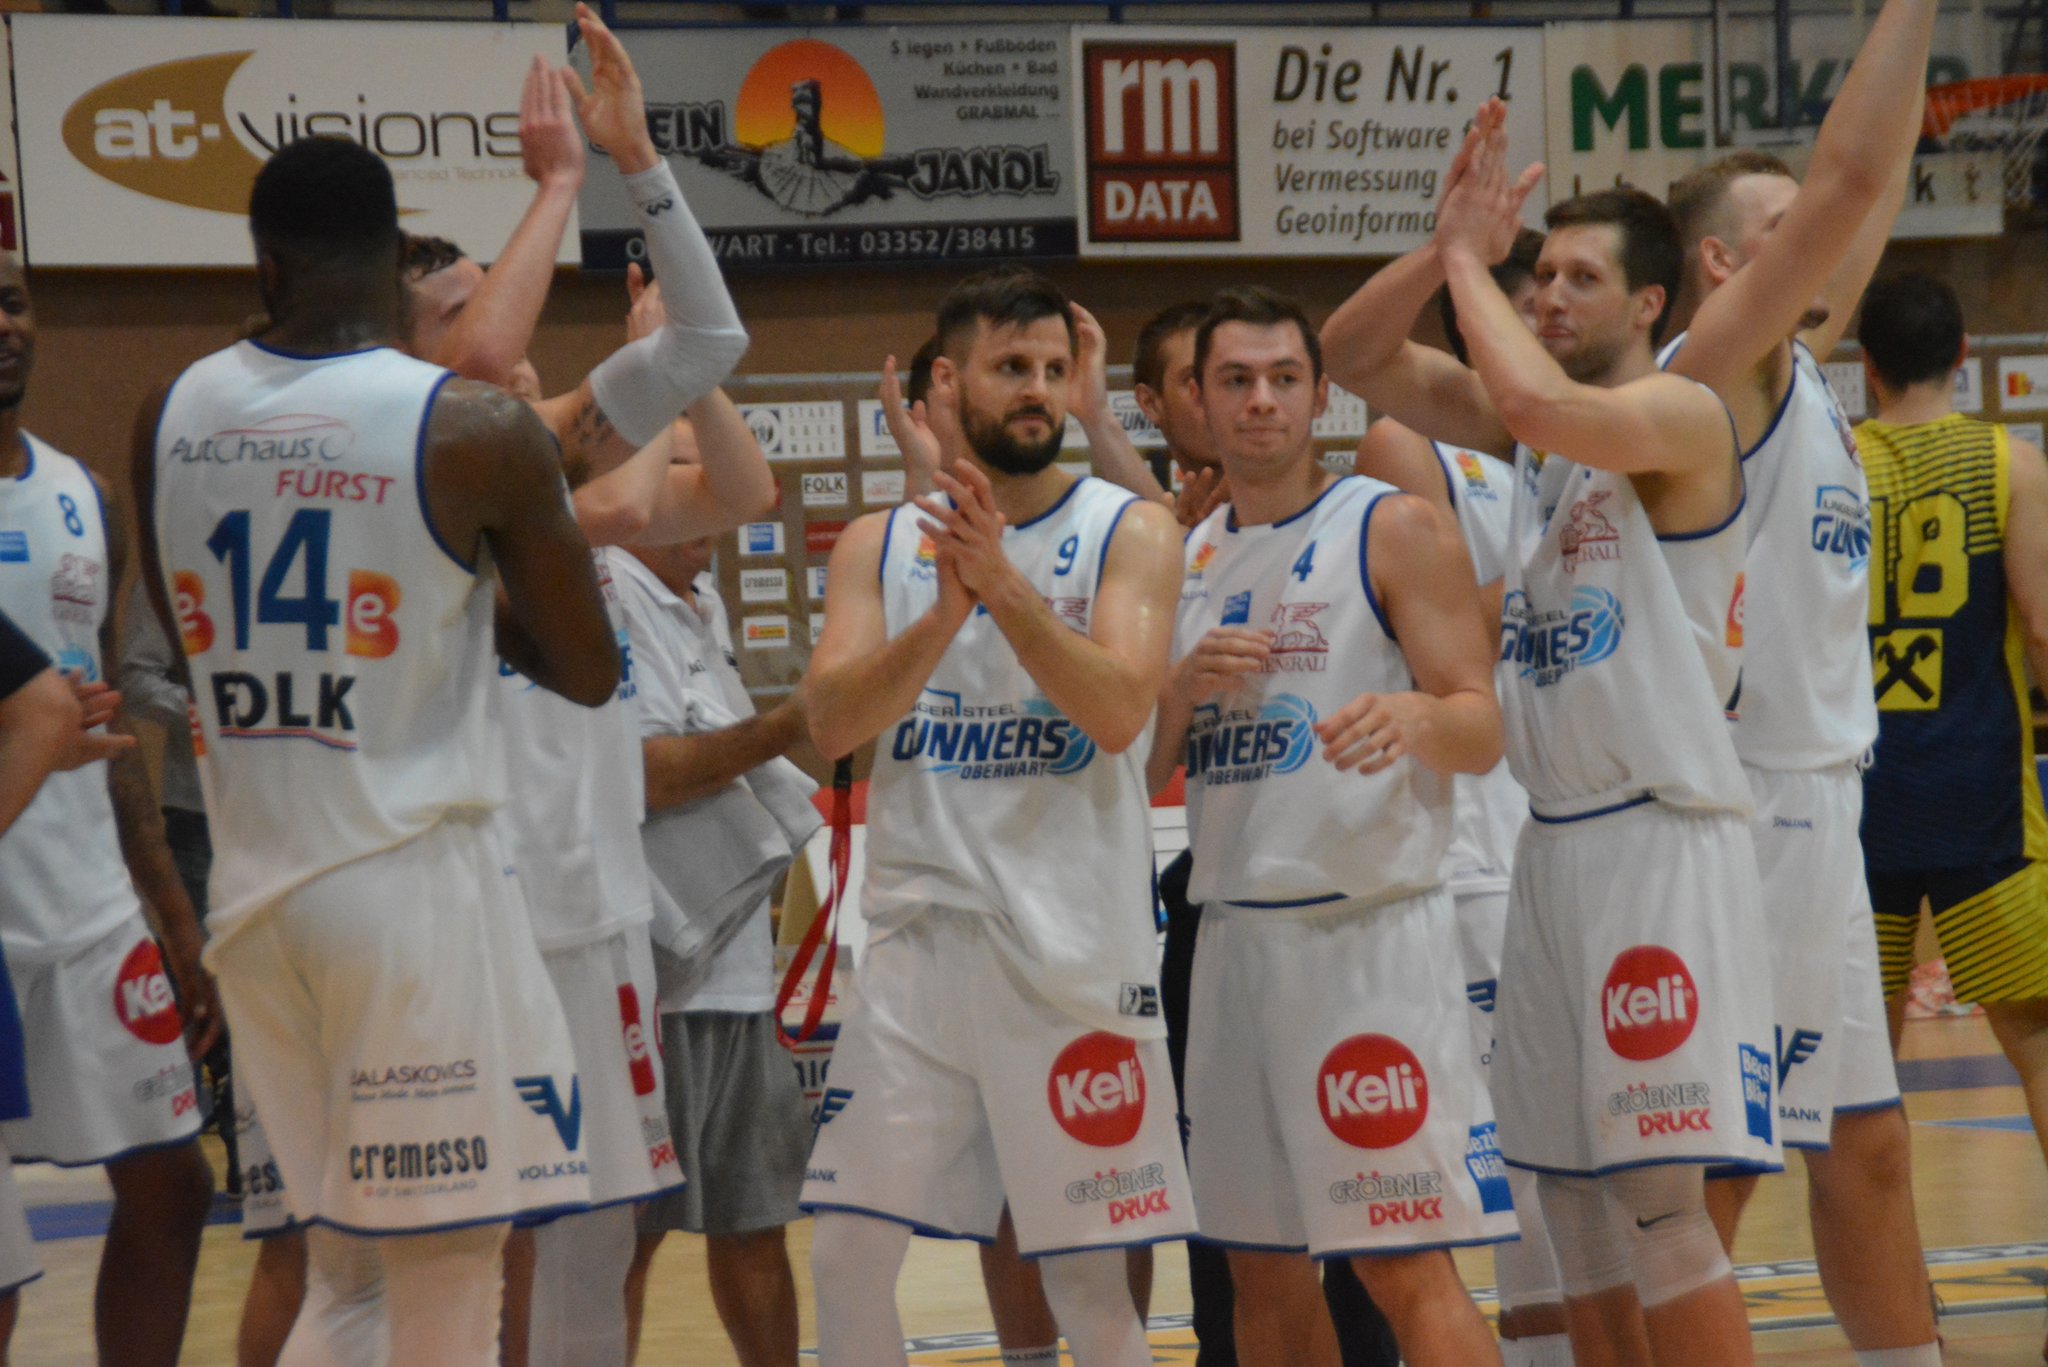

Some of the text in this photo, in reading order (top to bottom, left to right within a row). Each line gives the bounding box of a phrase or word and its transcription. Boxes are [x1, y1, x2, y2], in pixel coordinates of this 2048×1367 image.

[943, 60, 1057, 75] Küchen Bad
[1274, 44, 1515, 102] Die Nr. 1
[1102, 58, 1219, 154] rm
[1273, 119, 1315, 149] bei
[1327, 117, 1450, 158] Software
[910, 143, 1061, 198] JANDL
[1276, 163, 1437, 197] Vermessung
[1105, 181, 1219, 222] DATA
[799, 231, 852, 256] Tel.:
[861, 227, 1037, 255] 03352/38415
[275, 465, 396, 504] FÜRST
[58, 493, 84, 537] 8
[1053, 534, 1079, 577] 9
[1292, 540, 1317, 582] 4
[206, 508, 341, 652] 14
[963, 702, 1016, 718] STEEL
[960, 760, 1050, 781] OBERWART
[1607, 973, 1688, 1032] Keli
[1057, 1055, 1144, 1119] Keli
[1324, 1062, 1419, 1118] Keli
[1637, 1107, 1713, 1138] DRUCK
[351, 1134, 489, 1181] cremesso
[1065, 1162, 1166, 1205] GRÖBNER
[1329, 1170, 1443, 1204] GRÖBNER
[1108, 1188, 1172, 1226] DRUCK
[1368, 1197, 1444, 1228] DRUCK
